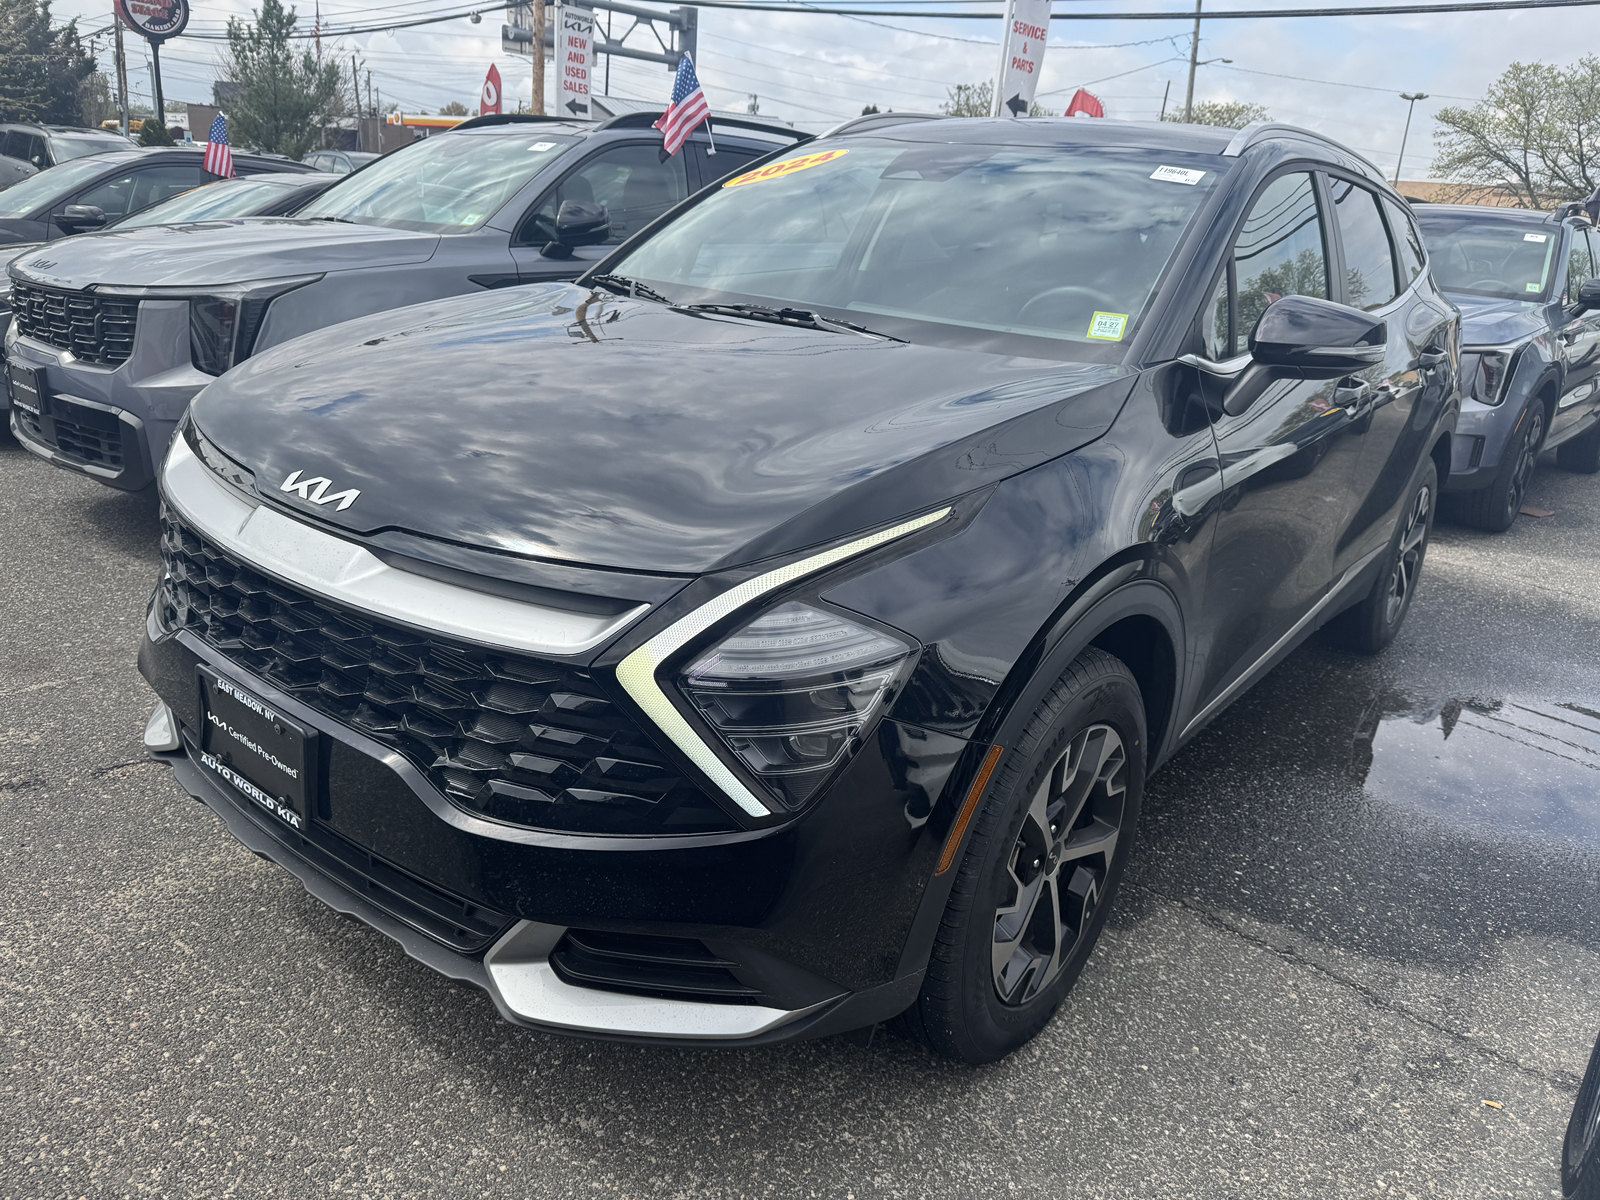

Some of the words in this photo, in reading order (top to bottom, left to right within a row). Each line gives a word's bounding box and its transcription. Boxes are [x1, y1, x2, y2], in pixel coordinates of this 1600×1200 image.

[564, 11, 594, 24] AUTOWORLD
[564, 20, 593, 34] KIA
[1013, 20, 1047, 41] SERVICE
[567, 35, 588, 50] NEW
[567, 51, 585, 65] AND
[1012, 56, 1035, 74] PARTS
[565, 65, 587, 80] USED
[563, 80, 589, 95] SALES
[733, 151, 837, 186] 2024
[280, 469, 361, 512] KIA
[217, 679, 233, 697] EAST
[264, 710, 276, 722] NY
[207, 711, 227, 731] KIA
[228, 726, 257, 753] Certified
[201, 754, 231, 780] AUTO
[233, 775, 274, 810] WORLD
[277, 806, 300, 829] KIA
